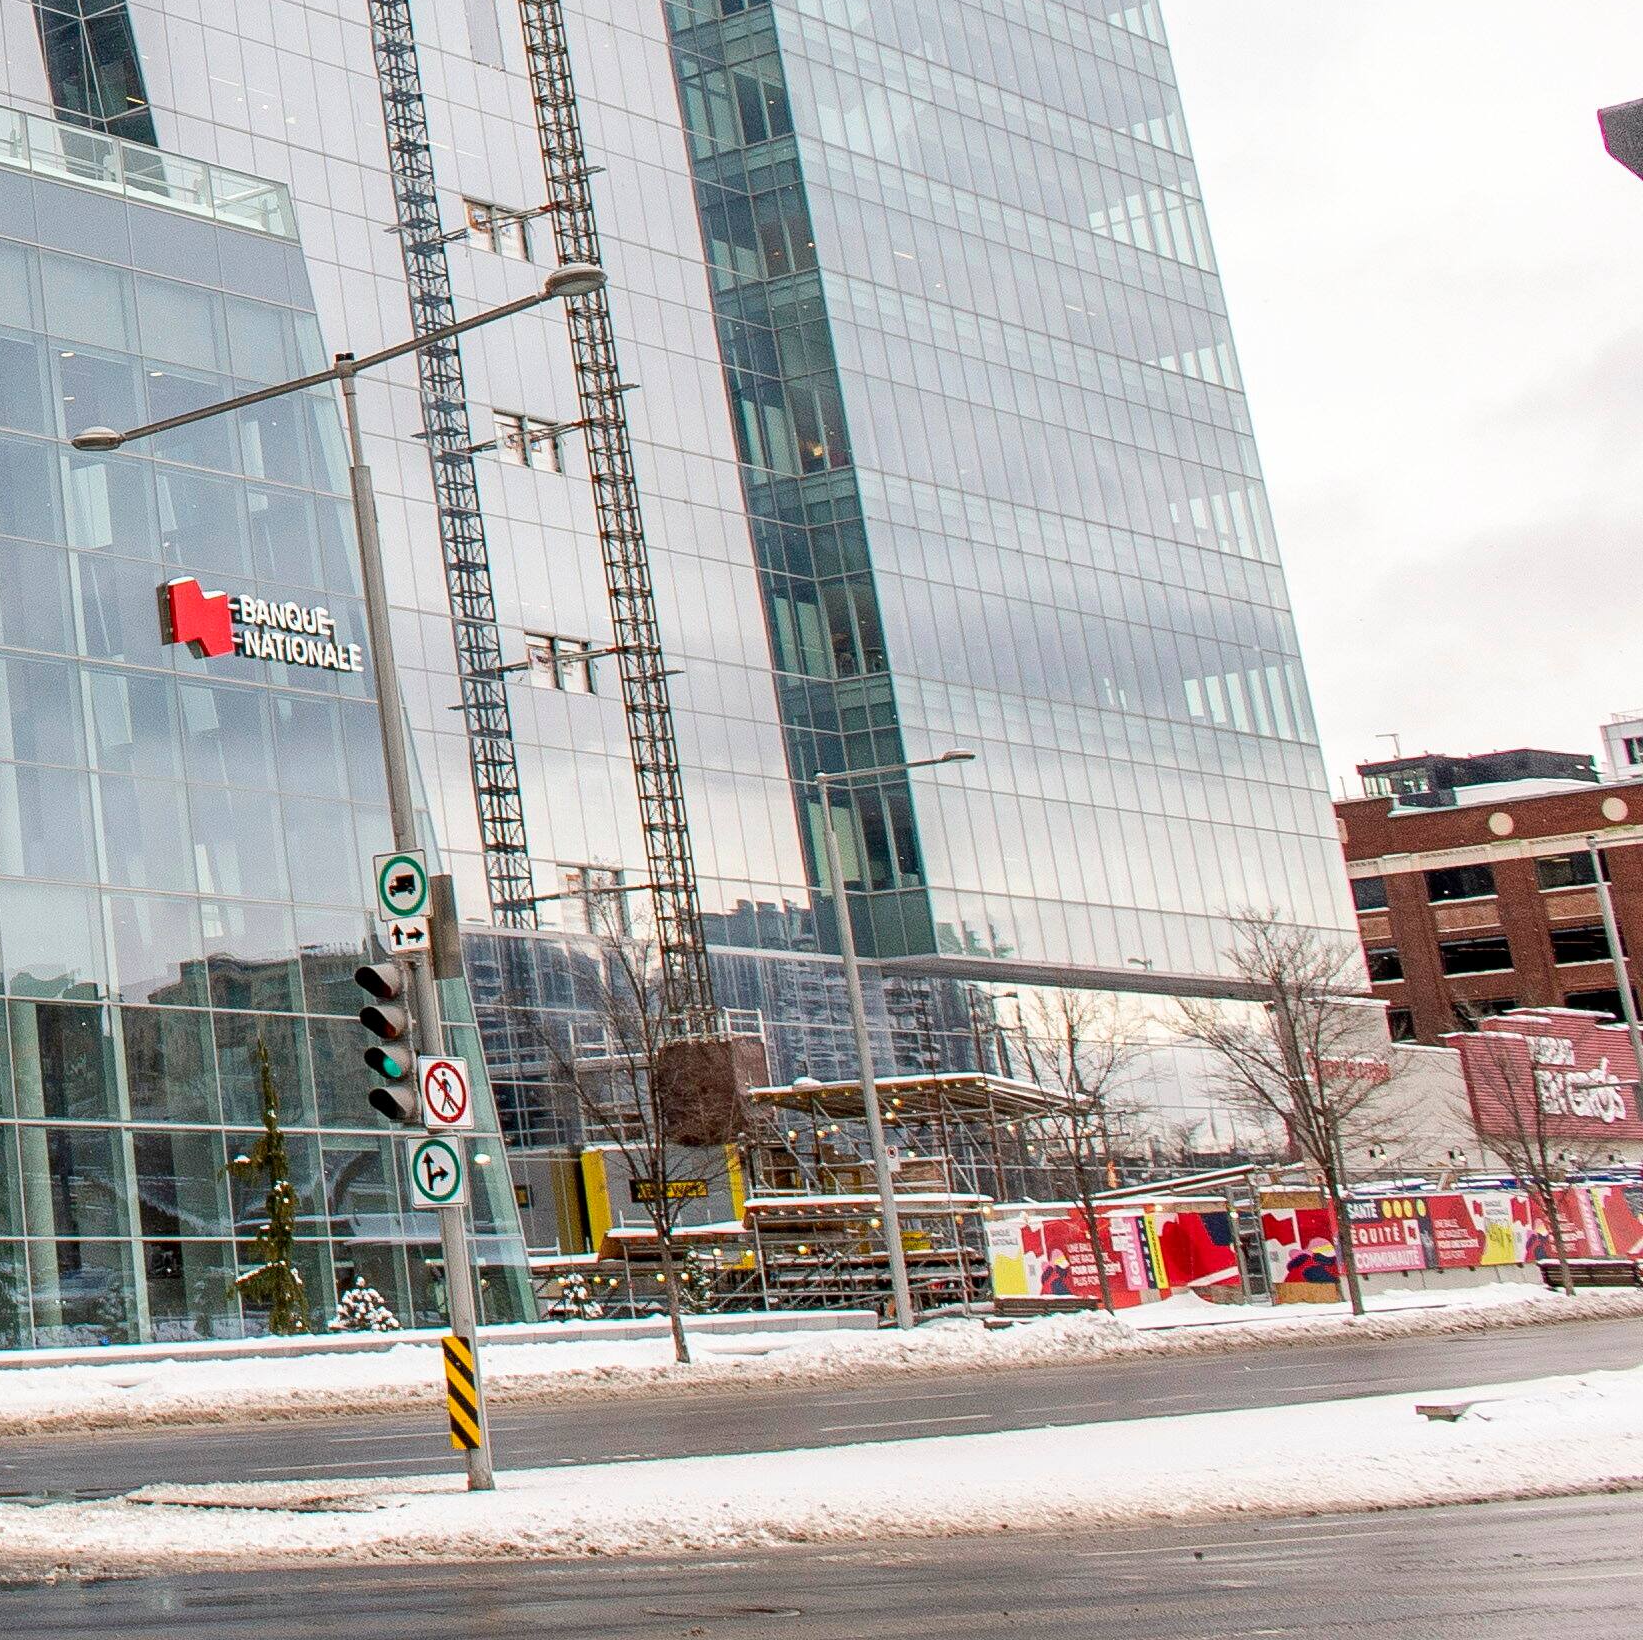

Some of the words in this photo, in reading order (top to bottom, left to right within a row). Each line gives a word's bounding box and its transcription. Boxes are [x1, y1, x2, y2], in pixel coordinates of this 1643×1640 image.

[238, 594, 331, 635] BANQUE
[244, 631, 364, 672] NATIONALE
[1346, 1199, 1379, 1220] SANTÉ
[1351, 1223, 1401, 1245] ÉQUITÉ
